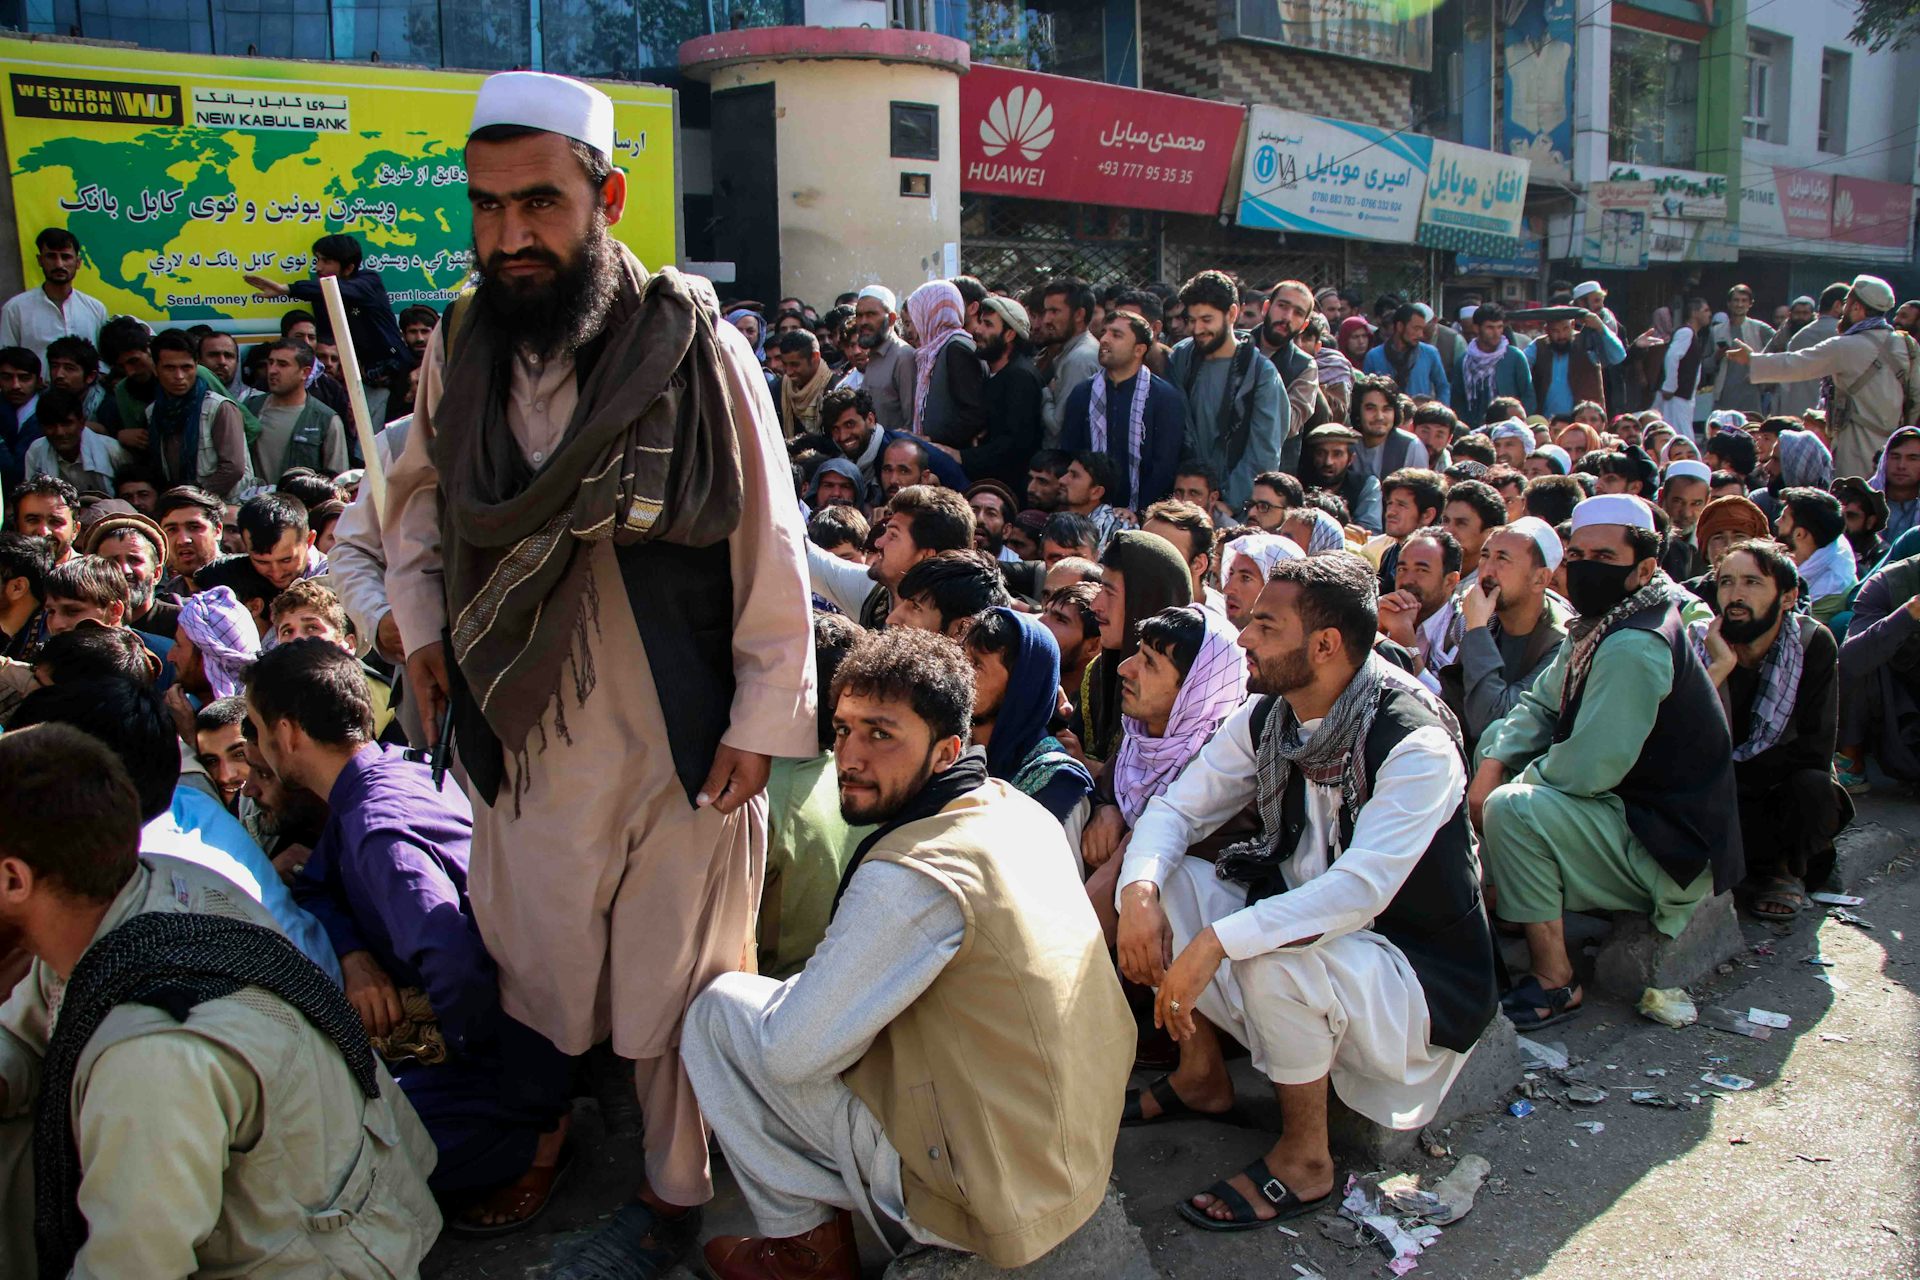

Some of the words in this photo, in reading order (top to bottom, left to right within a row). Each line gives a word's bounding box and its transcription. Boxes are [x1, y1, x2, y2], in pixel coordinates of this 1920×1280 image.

[16, 84, 112, 102] WESTERN
[195, 92, 254, 108] بانک
[258, 95, 302, 109] کابل
[49, 100, 113, 115] UNION
[121, 91, 173, 118] WU
[306, 99, 347, 111] نوی
[196, 111, 235, 125] NEW
[239, 114, 300, 128] KABUL
[303, 117, 348, 130] BANK
[613, 130, 646, 157] ارسا
[1100, 119, 1149, 150] مبایل
[1147, 131, 1206, 153] محمدی
[378, 164, 413, 185] طریق
[415, 165, 428, 186] از
[968, 161, 1046, 187] HUAWEI
[1097, 160, 1119, 176] +93
[1121, 162, 1144, 178] 777
[1145, 165, 1161, 181] 95
[1162, 167, 1177, 182] 35
[1178, 169, 1194, 184] 35
[1306, 152, 1360, 186] موبایل
[1364, 167, 1412, 192] امیری
[1428, 157, 1477, 207] موبایل
[1481, 168, 1524, 210] افغان
[60, 183, 118, 219] بانک
[127, 188, 184, 222] کابل
[1739, 187, 1775, 206] PRIME
[190, 193, 237, 222] نوی
[244, 200, 256, 223] و
[264, 194, 321, 223] یونین
[328, 197, 397, 225] ویسترن
[188, 253, 201, 268] له
[206, 251, 238, 271] بانک
[243, 252, 276, 273] کابل
[366, 253, 409, 272] ویسترن
[411, 255, 421, 267] د
[167, 294, 200, 306] Send
[205, 295, 248, 307] money
[252, 294, 263, 304] to
[268, 294, 299, 304] more
[387, 290, 414, 304] gent
[416, 289, 461, 301] location
